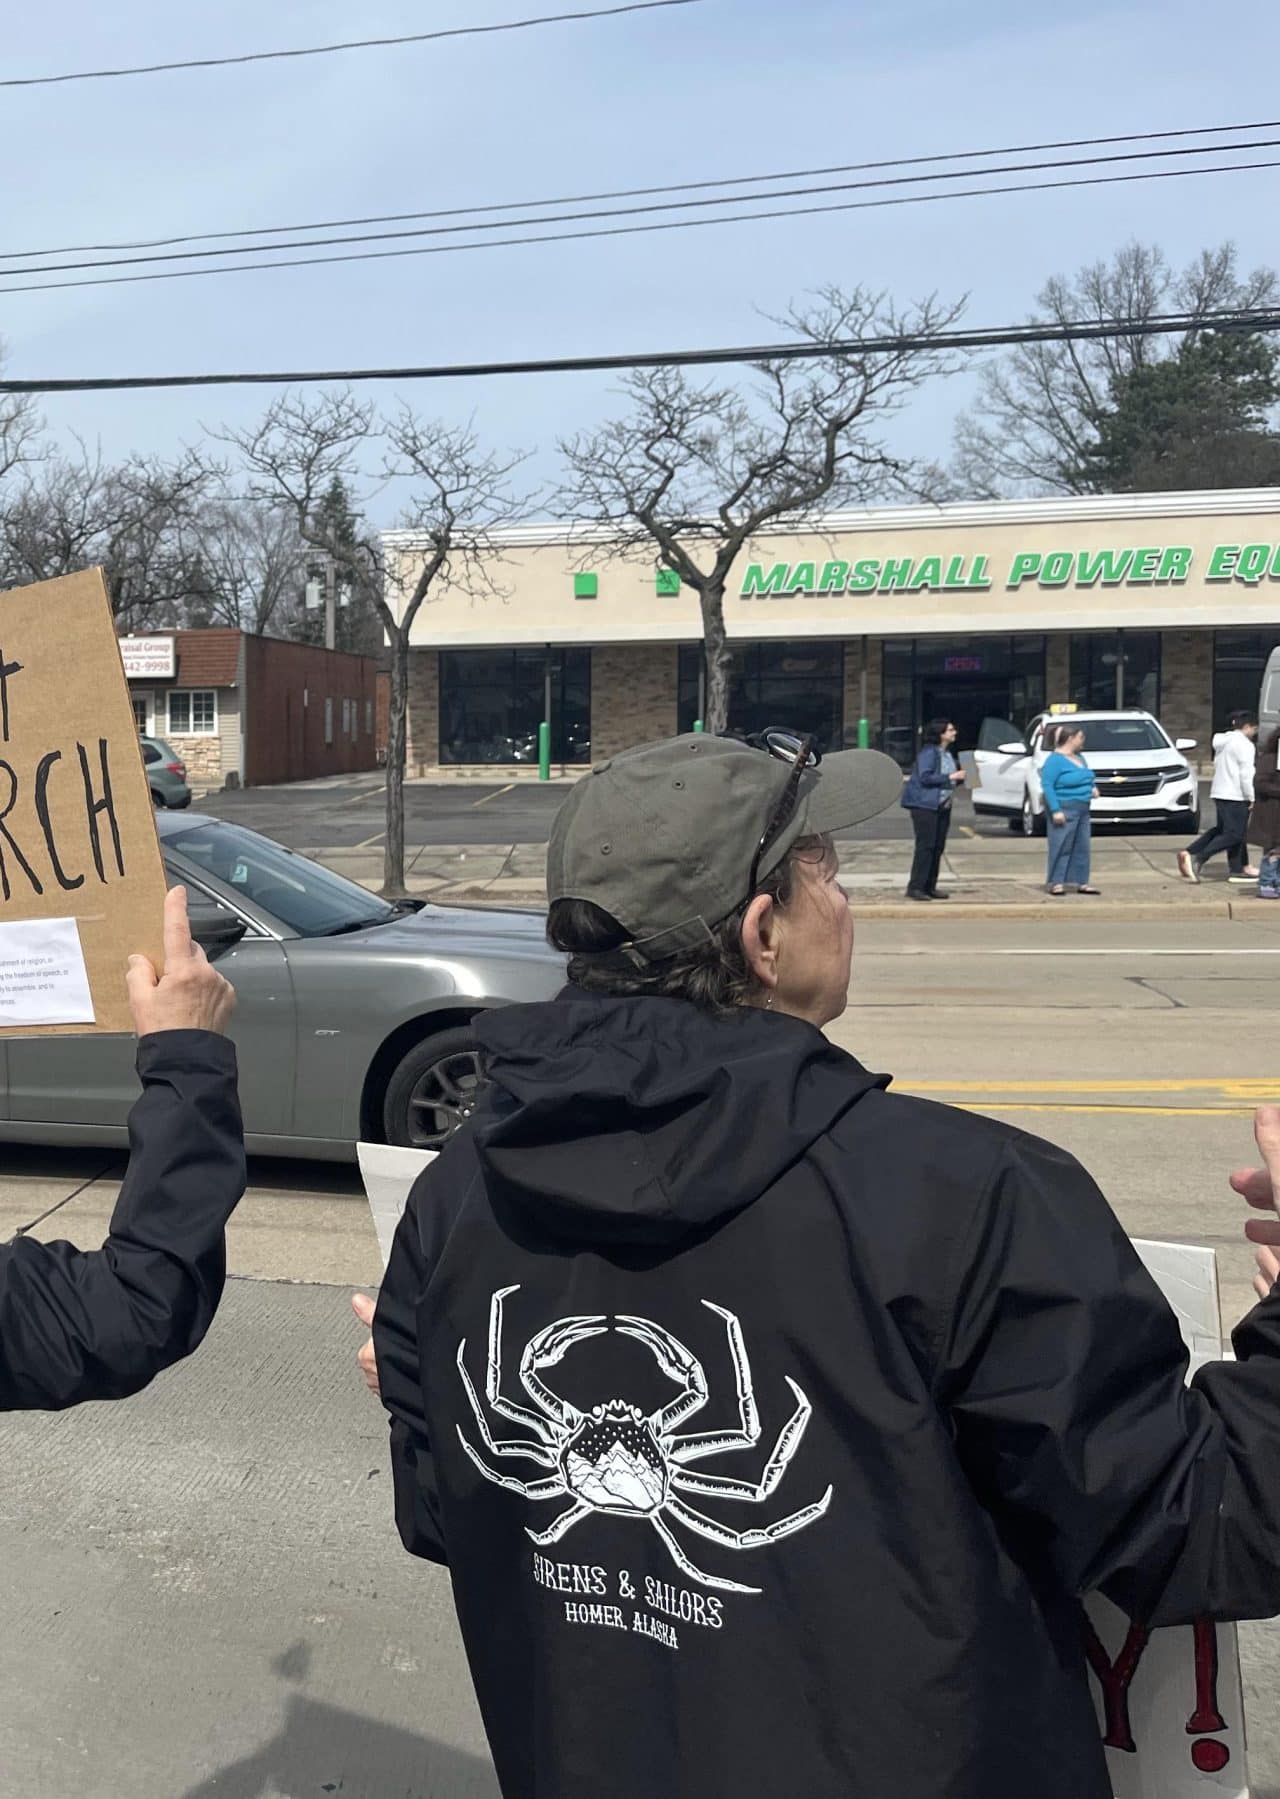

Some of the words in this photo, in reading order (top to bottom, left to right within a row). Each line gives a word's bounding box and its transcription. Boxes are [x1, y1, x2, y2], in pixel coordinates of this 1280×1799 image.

[740, 554, 993, 597] MARSHALL
[1007, 545, 1193, 586] POWER
[533, 1552, 607, 1595] SIRENS
[619, 1570, 636, 1599] &
[644, 1576, 724, 1628] SAILORS
[564, 1602, 628, 1630] HOMER,
[632, 1611, 679, 1649] ALASKA
